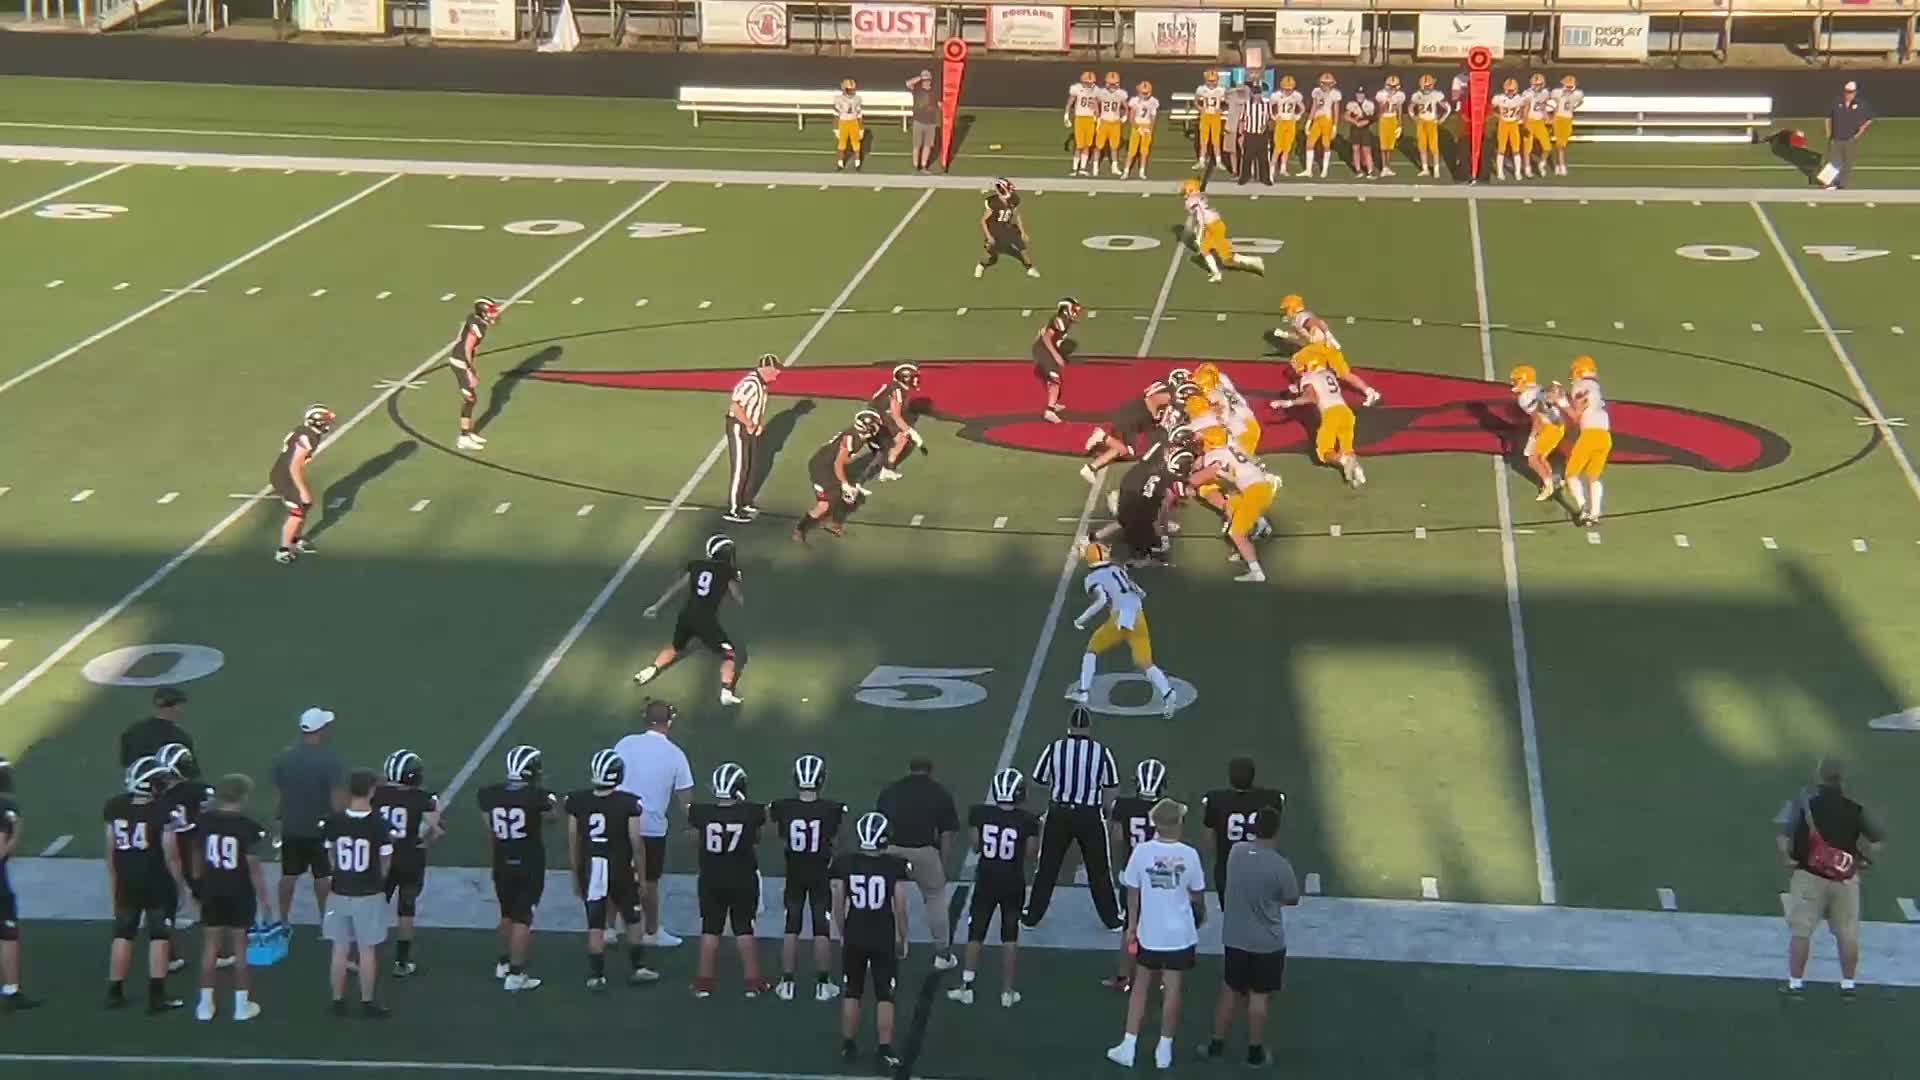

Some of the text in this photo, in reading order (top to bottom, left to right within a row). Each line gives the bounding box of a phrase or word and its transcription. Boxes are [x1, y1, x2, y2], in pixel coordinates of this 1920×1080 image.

[854, 9, 932, 34] GUST
[1594, 26, 1643, 38] DISPLAY
[1593, 36, 1625, 48] PACK
[1325, 375, 1339, 394] 9
[696, 570, 713, 597] 9
[113, 818, 149, 850] 54
[491, 807, 528, 840] 62
[588, 813, 609, 842] 2
[705, 822, 744, 854] 67
[788, 818, 822, 853] 61
[206, 833, 239, 870] 49
[335, 835, 371, 873] 60
[981, 823, 1018, 861] 56
[849, 874, 886, 910] 50
